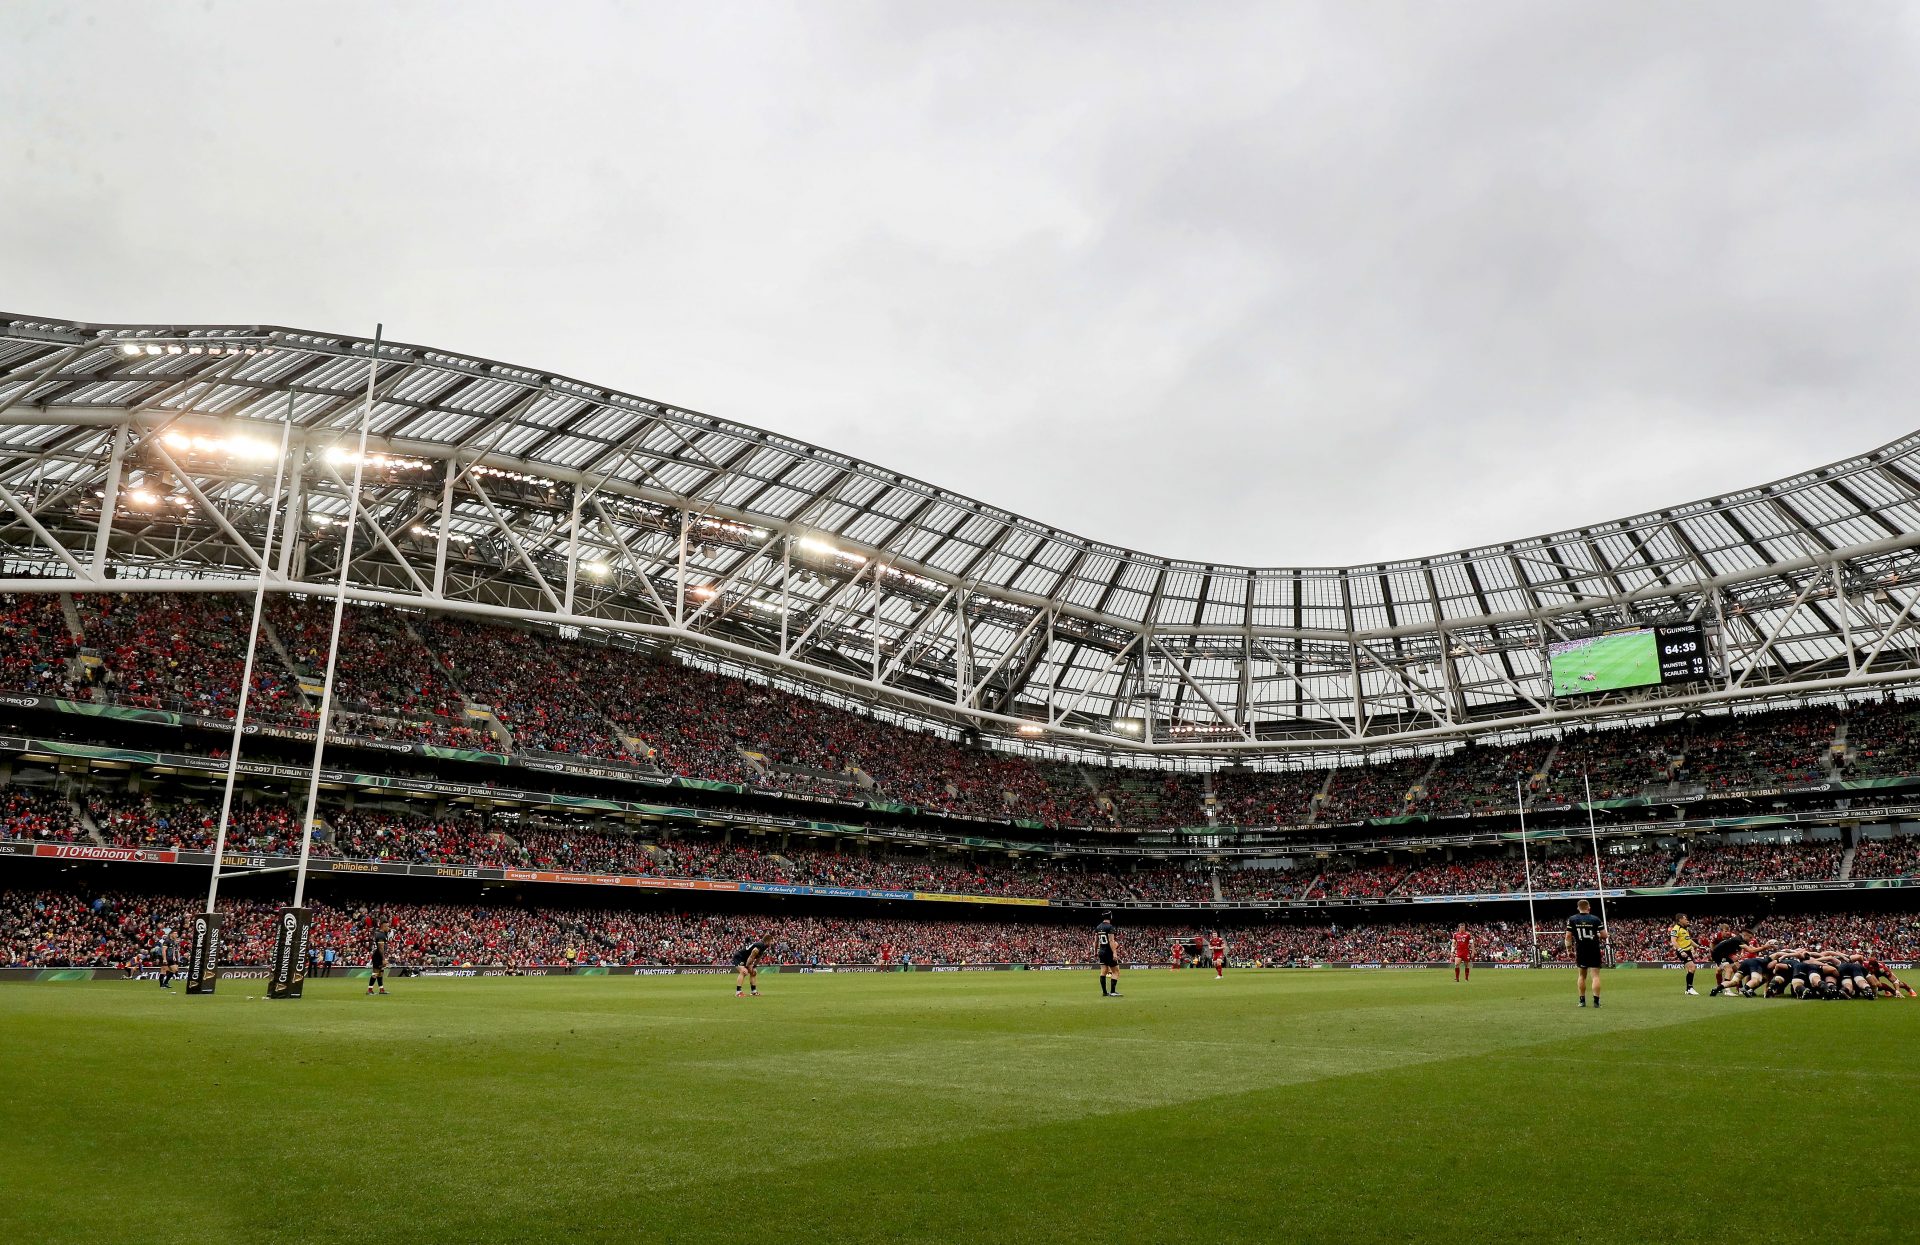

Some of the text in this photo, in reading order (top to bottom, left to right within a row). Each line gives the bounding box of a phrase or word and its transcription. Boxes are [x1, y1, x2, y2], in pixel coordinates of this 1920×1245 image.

[1666, 625, 1695, 634] GUINNESS
[1665, 642, 1696, 655] 64:39
[1663, 657, 1702, 669] MUNSTER 10
[1664, 666, 1704, 677] SCARLETS 32
[203, 721, 232, 730] GUINNESS
[262, 727, 294, 738] FINAL
[294, 731, 318, 741] 2017
[277, 768, 302, 776] DUBLIN
[566, 766, 588, 774] FINAL
[607, 770, 632, 780] DUBLIN
[801, 794, 814, 802] 2017
[1706, 792, 1730, 800] FINAL
[1730, 791, 1749, 799] 2017
[1751, 788, 1781, 796] DUBLIN
[1472, 810, 1492, 818] FINAL
[56, 847, 132, 861] TJ O'Mahony
[220, 857, 266, 867] HILIPLEE
[332, 862, 379, 872] philiplee.ie
[437, 868, 478, 878] PHILIPLEE
[1576, 928, 1595, 941] 14
[192, 918, 207, 980] GUINNESS PRO12
[206, 928, 219, 970] GUINNESS
[279, 913, 297, 982] GUINNESS PRO12
[296, 925, 309, 972] GUINNESS
